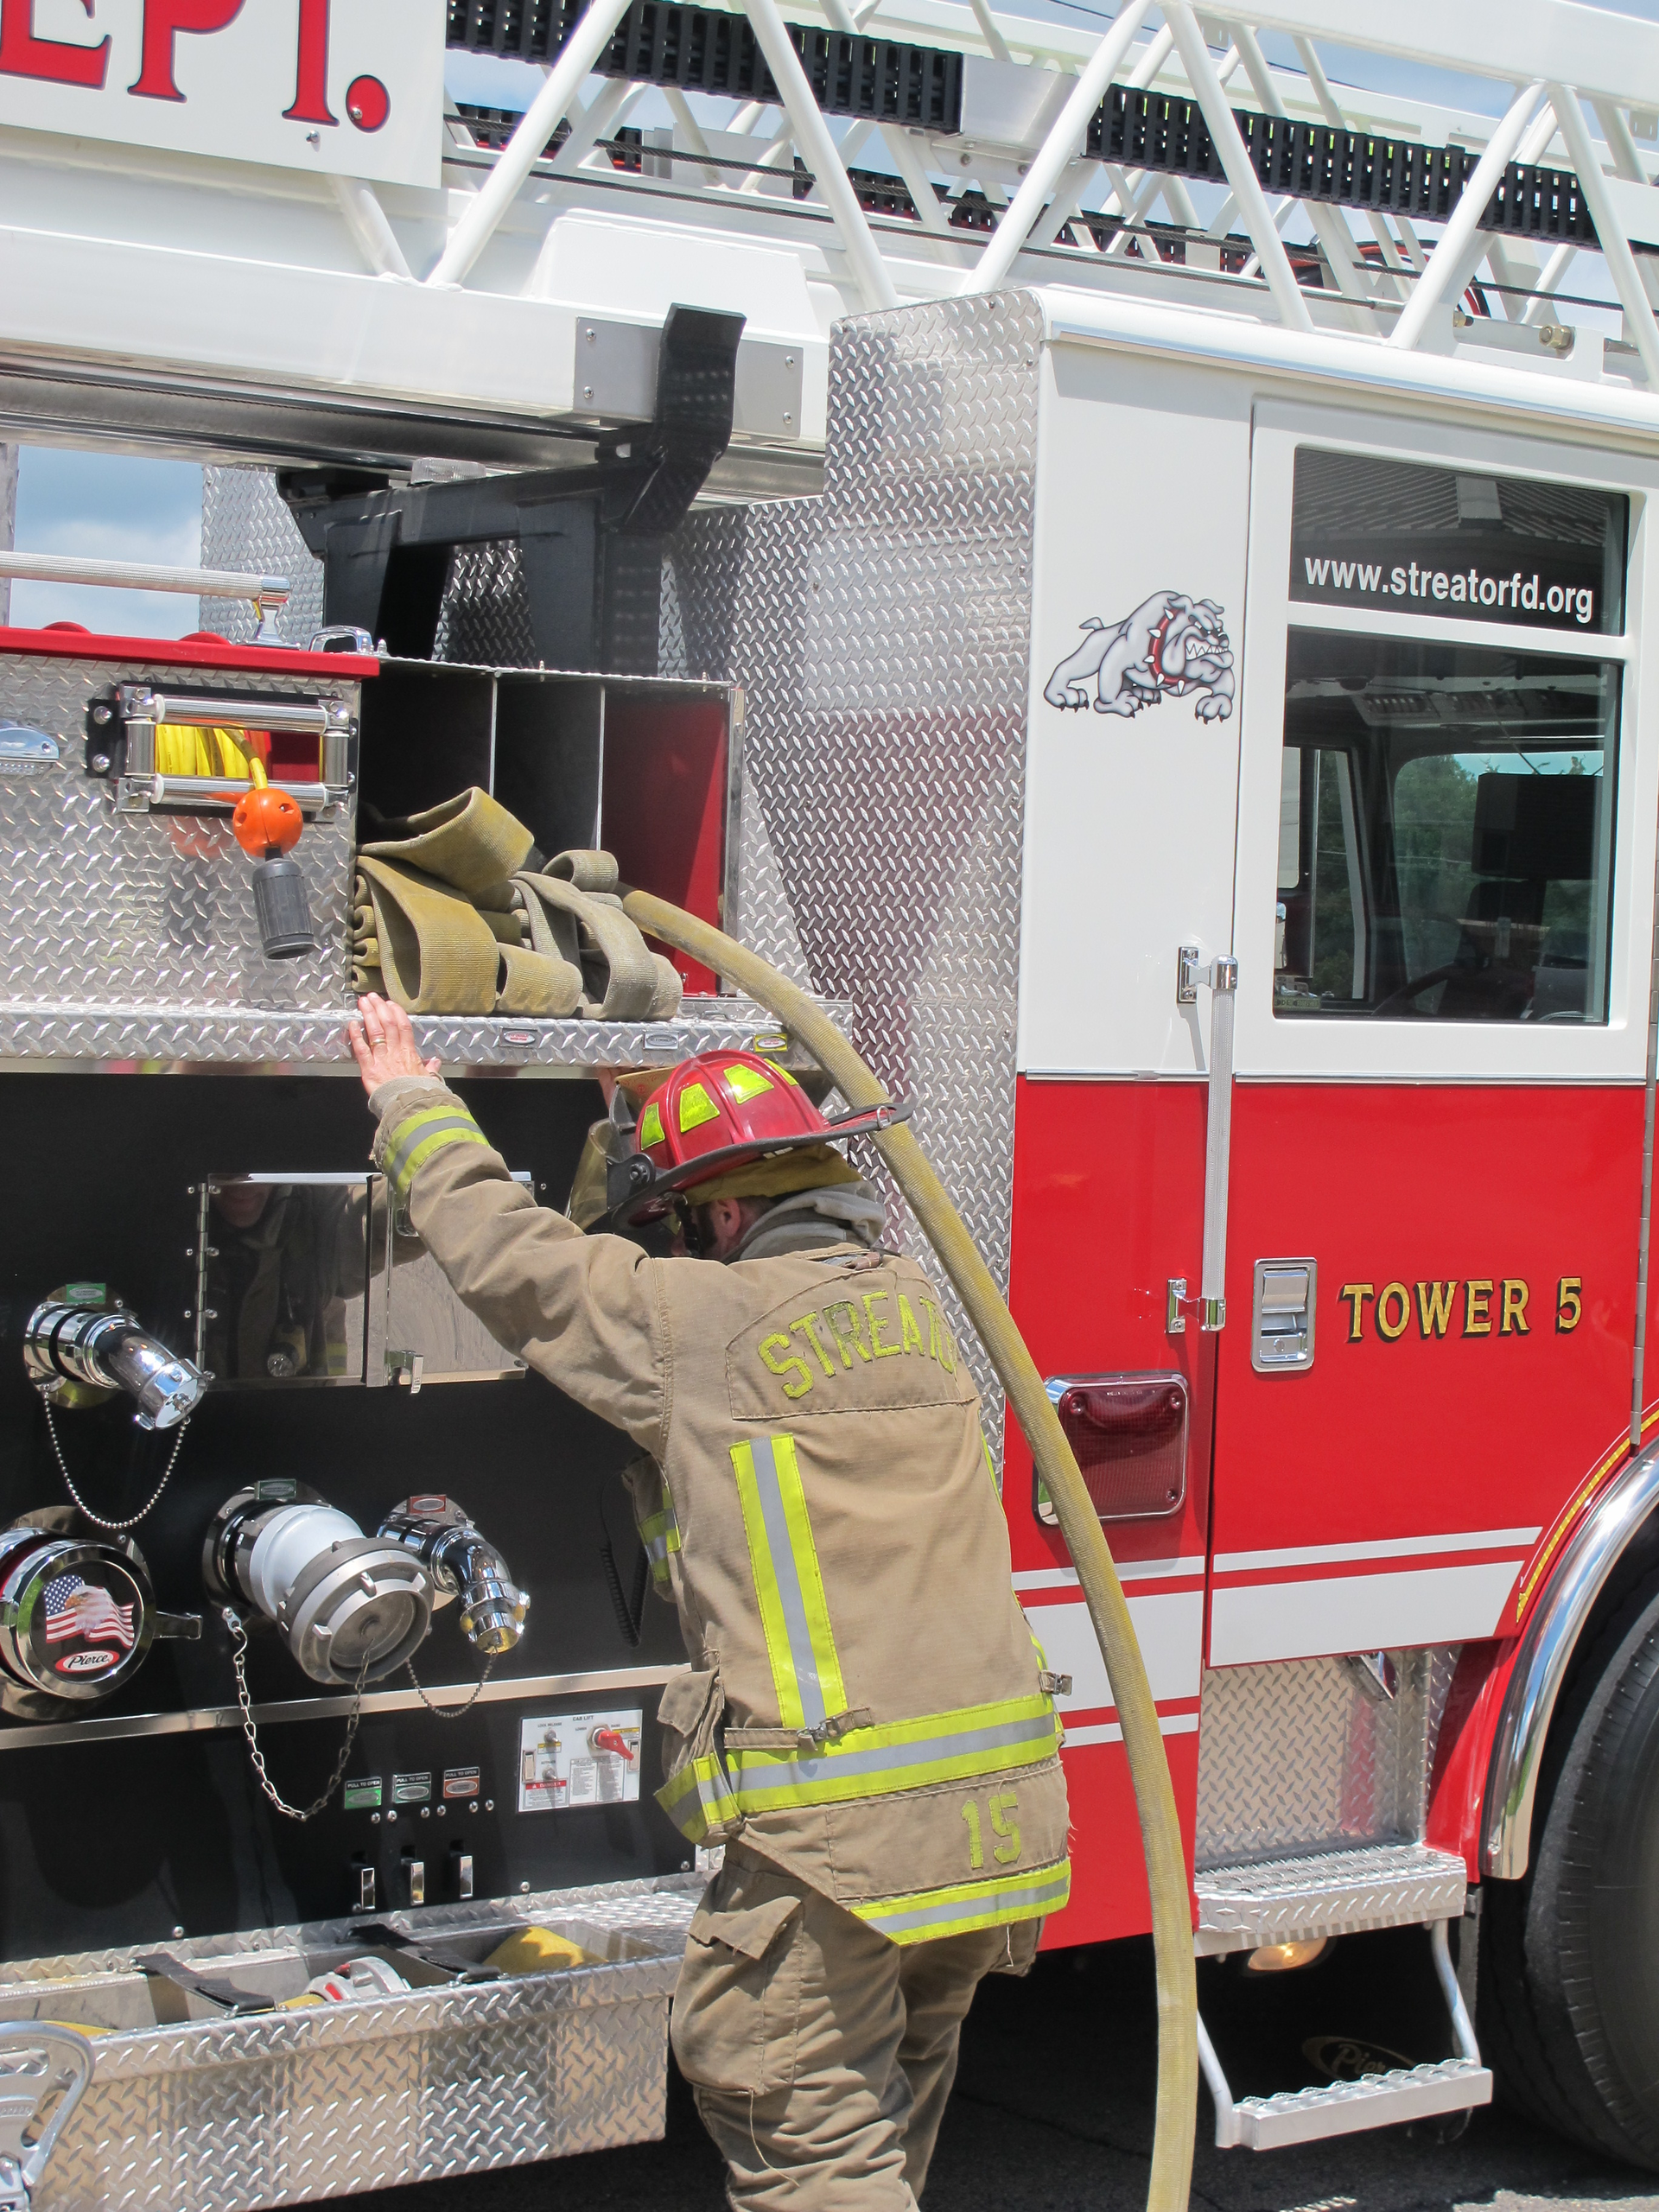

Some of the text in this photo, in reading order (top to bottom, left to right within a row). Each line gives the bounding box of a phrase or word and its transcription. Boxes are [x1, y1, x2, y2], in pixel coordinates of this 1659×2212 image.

[1304, 557, 1593, 624] www.streatorfd.org
[1338, 1276, 1583, 1343] TOWER 5
[67, 1654, 109, 1669] Pierce
[960, 1791, 1022, 1870] 15
[1332, 2043, 1387, 2075] Pier
